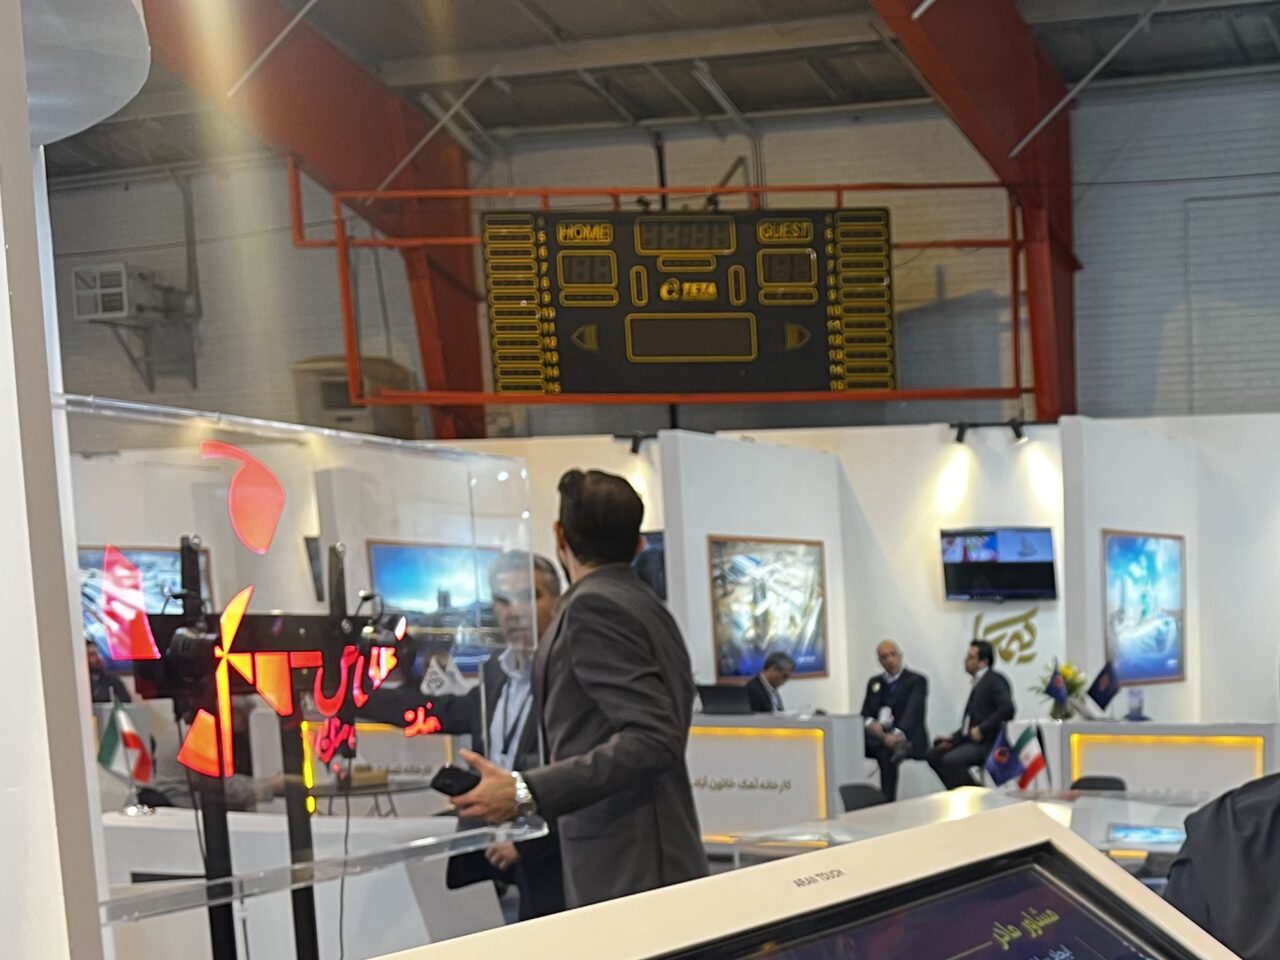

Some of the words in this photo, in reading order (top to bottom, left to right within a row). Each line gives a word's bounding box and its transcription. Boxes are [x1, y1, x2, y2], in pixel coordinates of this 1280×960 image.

[559, 224, 610, 241] HOME
[760, 222, 809, 239] GUEST
[760, 779, 792, 795] کارخانه
[1021, 908, 1059, 937] مشاور
[993, 922, 1021, 950] مادر
